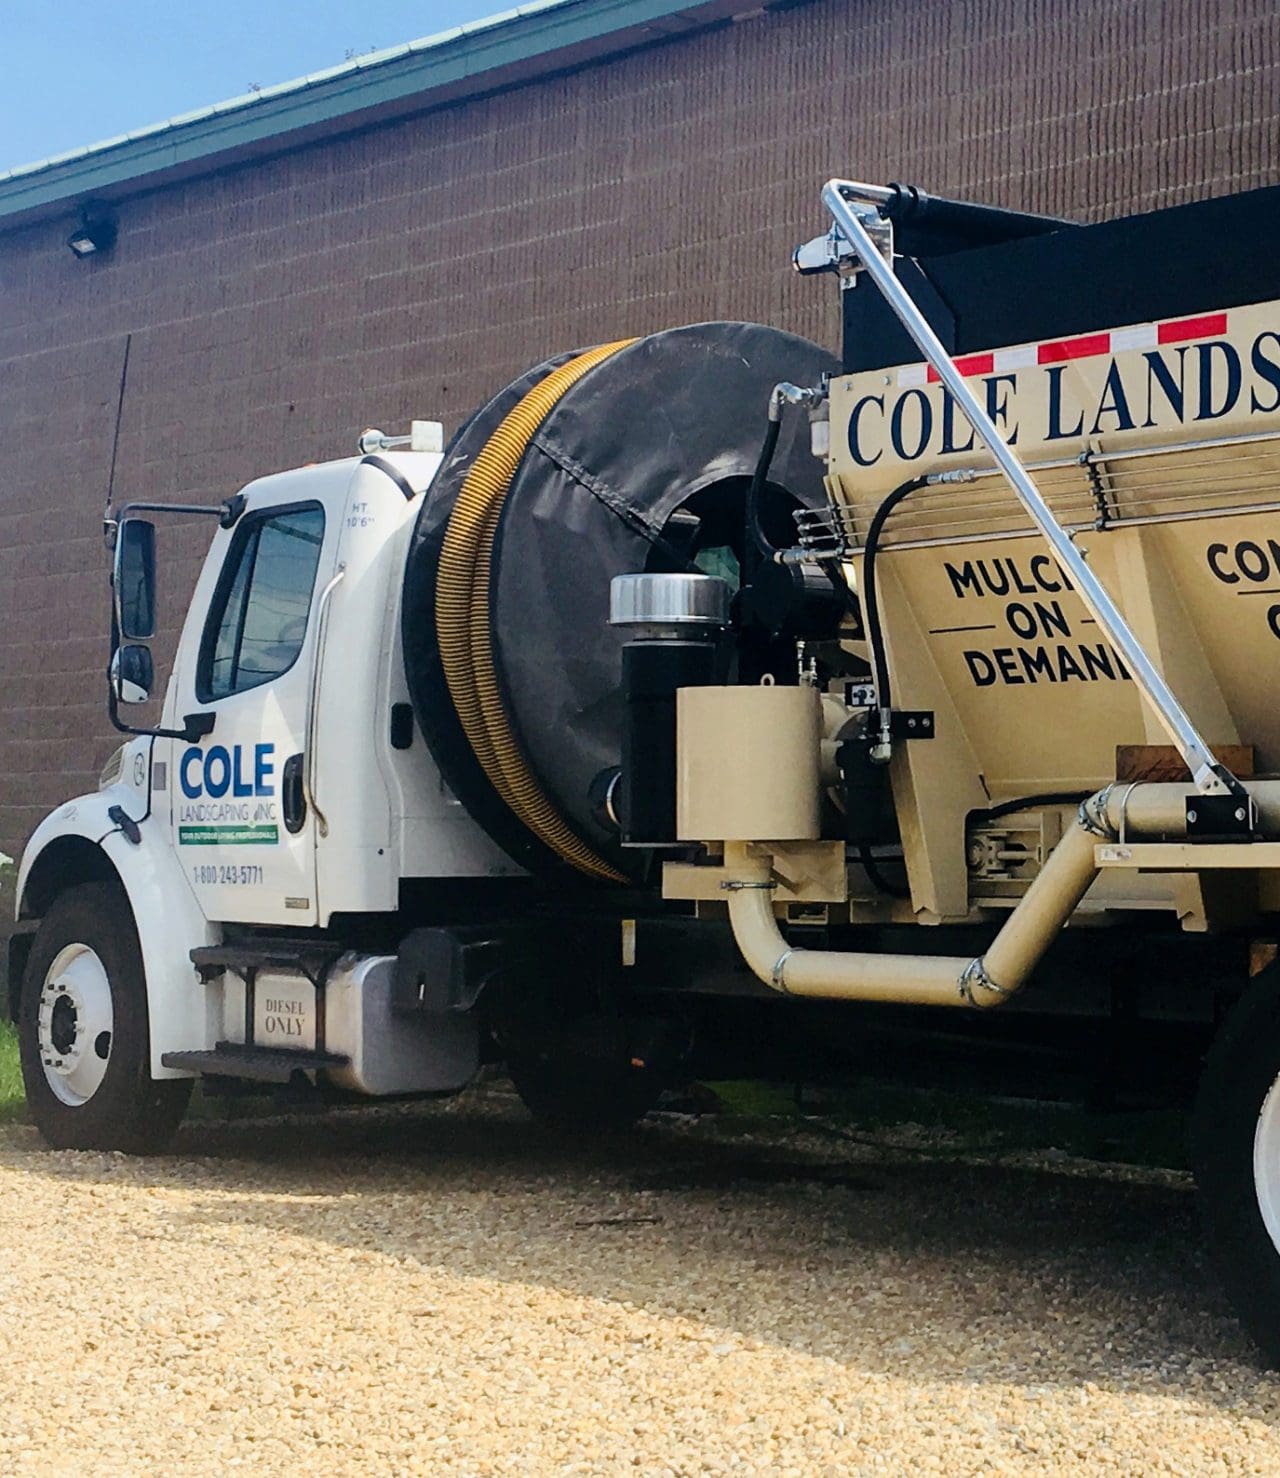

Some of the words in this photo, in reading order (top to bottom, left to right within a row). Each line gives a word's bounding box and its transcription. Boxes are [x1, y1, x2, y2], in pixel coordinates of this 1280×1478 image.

[848, 374, 1019, 466] COLE
[1006, 601, 1071, 640] ON
[180, 743, 275, 799] COLE
[180, 803, 249, 822] LANDSCAPING
[193, 865, 263, 885] 1-800-243-5771
[265, 999, 305, 1015] DIESEL
[265, 1015, 305, 1036] ONLY
